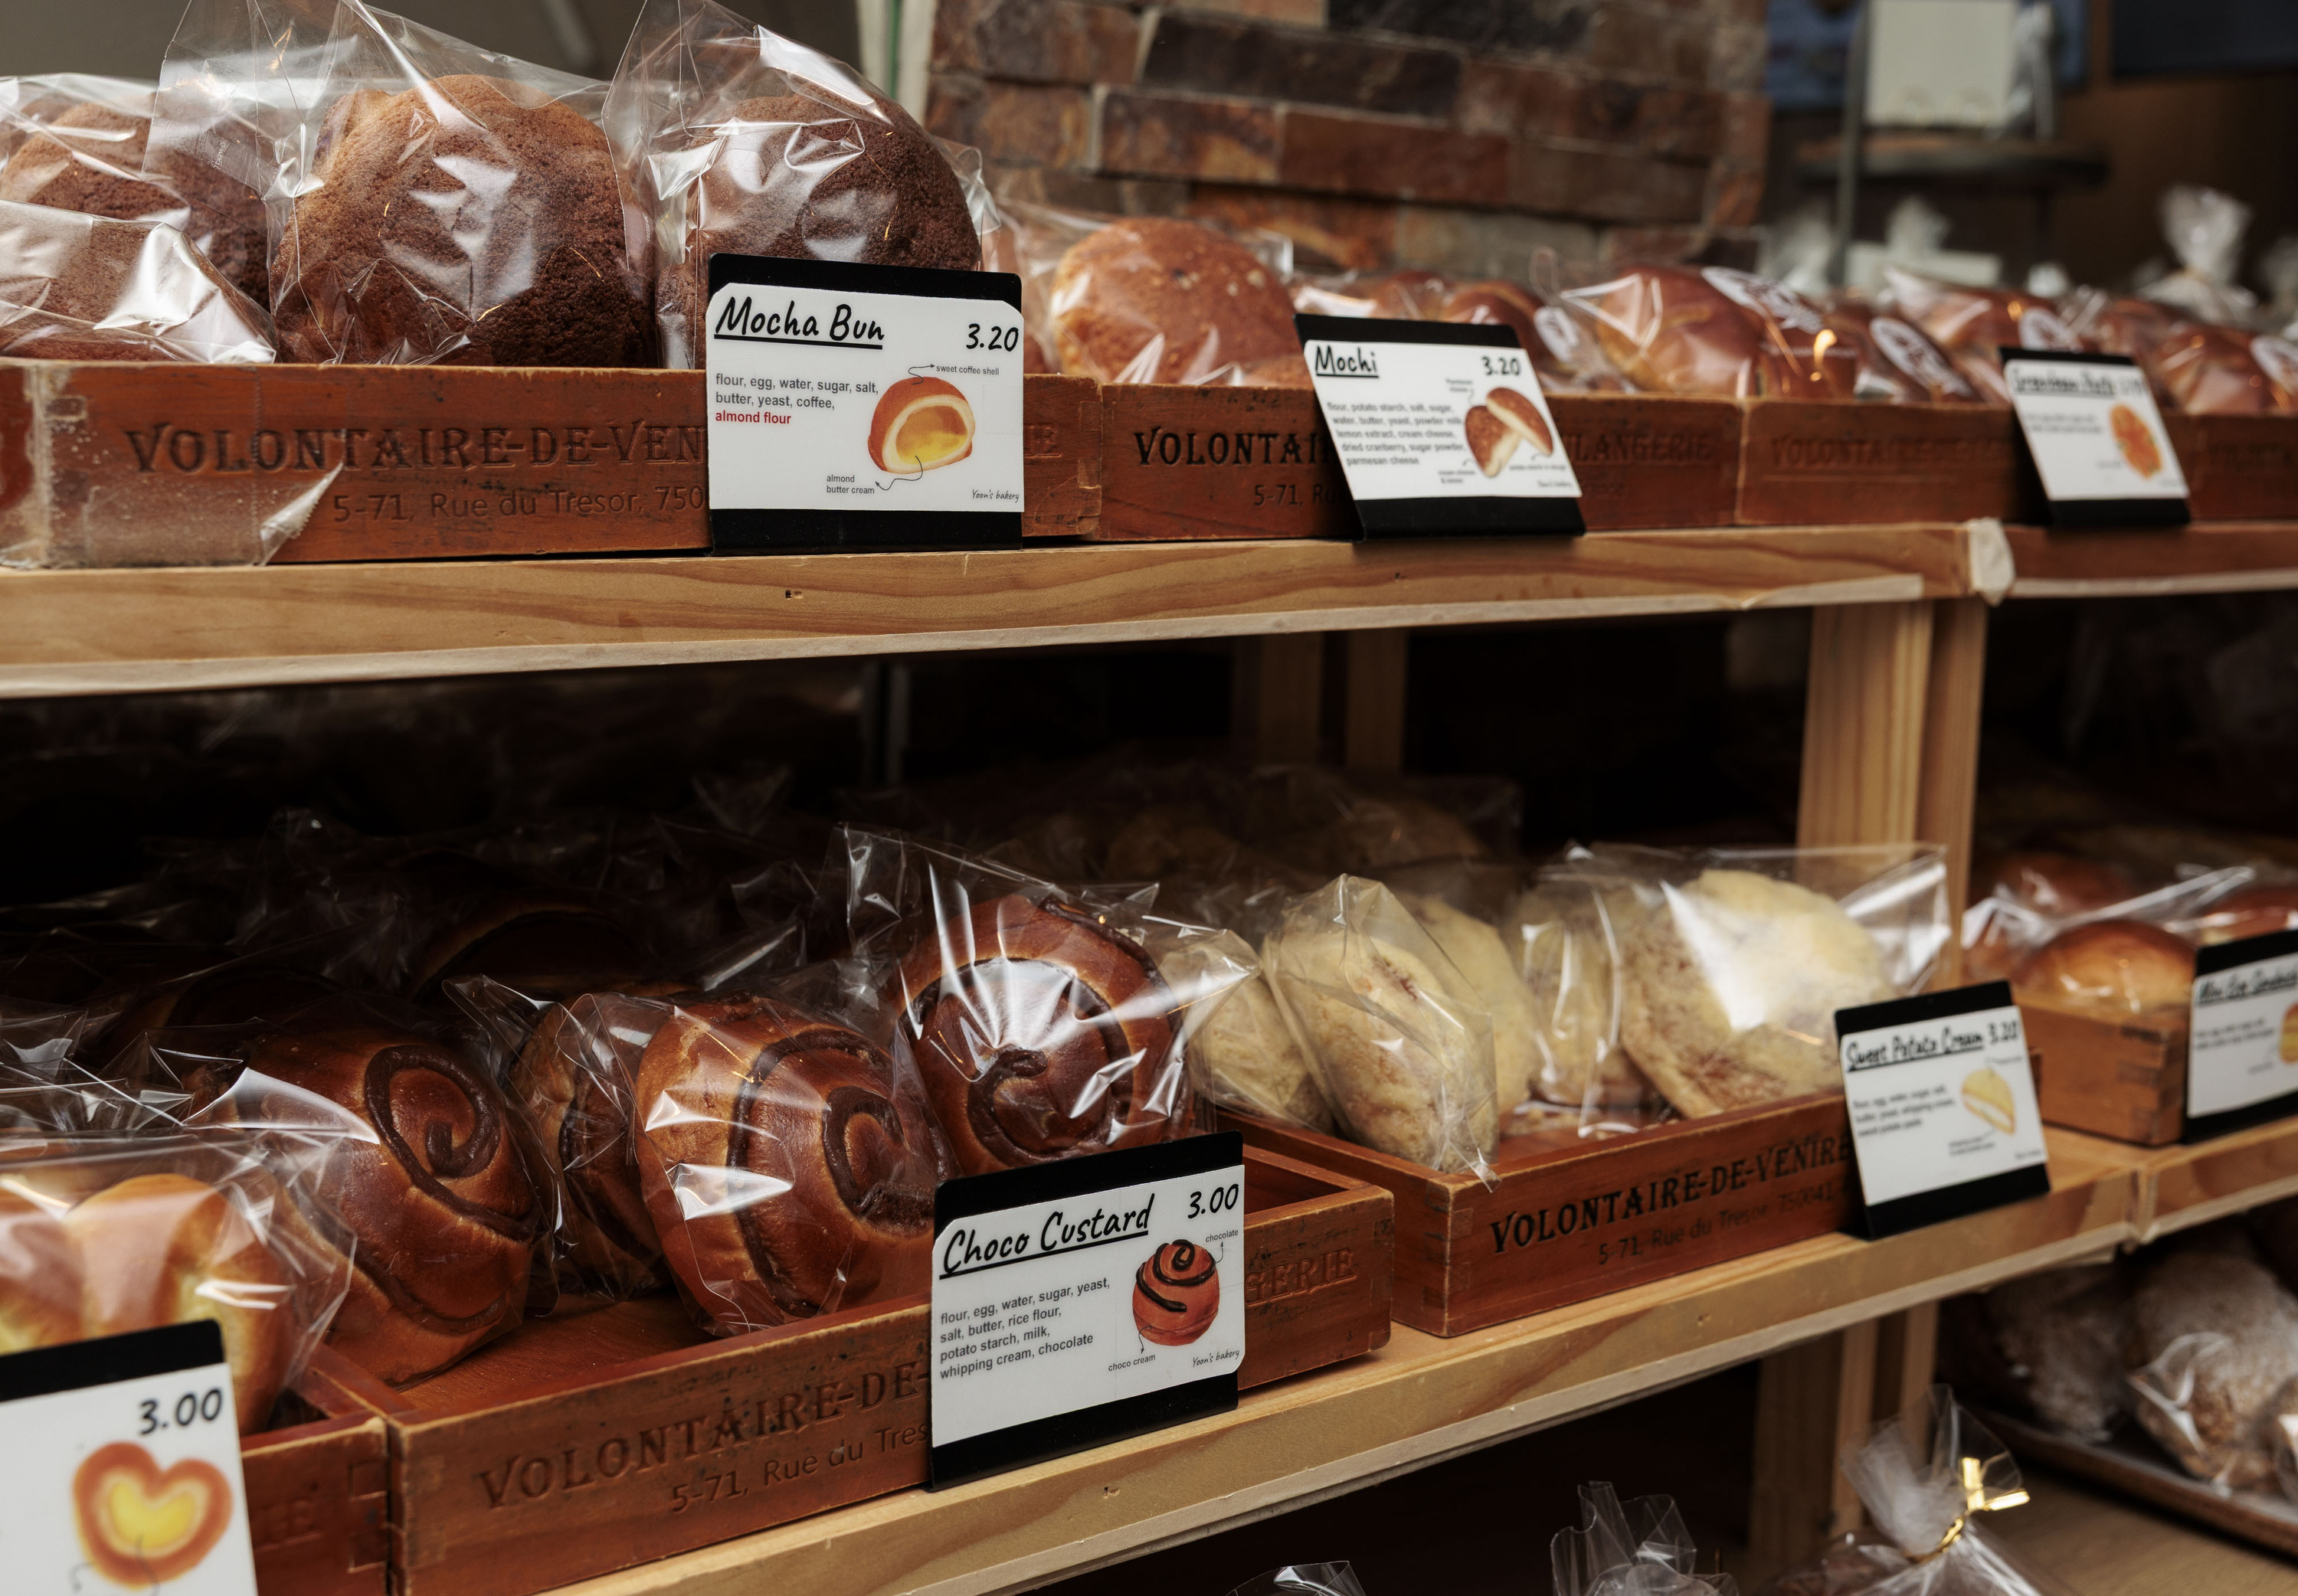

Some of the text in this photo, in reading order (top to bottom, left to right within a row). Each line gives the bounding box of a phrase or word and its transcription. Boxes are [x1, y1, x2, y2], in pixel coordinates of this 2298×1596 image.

[715, 296, 885, 342] Mocha Bun
[965, 323, 1019, 352] 3.20
[936, 365, 1000, 376] sweet coffee shell
[1315, 345, 1378, 374] Mochi
[1481, 356, 1521, 376] 3.20
[715, 373, 879, 394] flour, egg, water, sugar, salt,
[715, 391, 835, 410] butter, yeast, coffee,
[715, 410, 791, 425] almond flour
[827, 474, 855, 483] almond
[827, 486, 849, 494] butter
[432, 491, 489, 518] Rue
[502, 490, 537, 516] du
[972, 489, 1019, 503] Yoon's bakery
[1187, 1184, 1239, 1218] 3.00
[944, 1192, 1154, 1273] Choco Custard
[1206, 1228, 1239, 1243] chocolate
[941, 1277, 1110, 1325] flour, egg, water, sugar, yeast,
[941, 1306, 1062, 1343] salt, butter, rice flour,
[941, 1326, 1050, 1364] potato starch, milk,
[941, 1333, 1094, 1380] whipping cream, chocolate
[1192, 1349, 1240, 1368] Yoon's bakery
[1108, 1355, 1156, 1372] choco cream
[139, 1388, 223, 1435] 3.00
[764, 1450, 817, 1488] Rue
[828, 1438, 863, 1467] du
